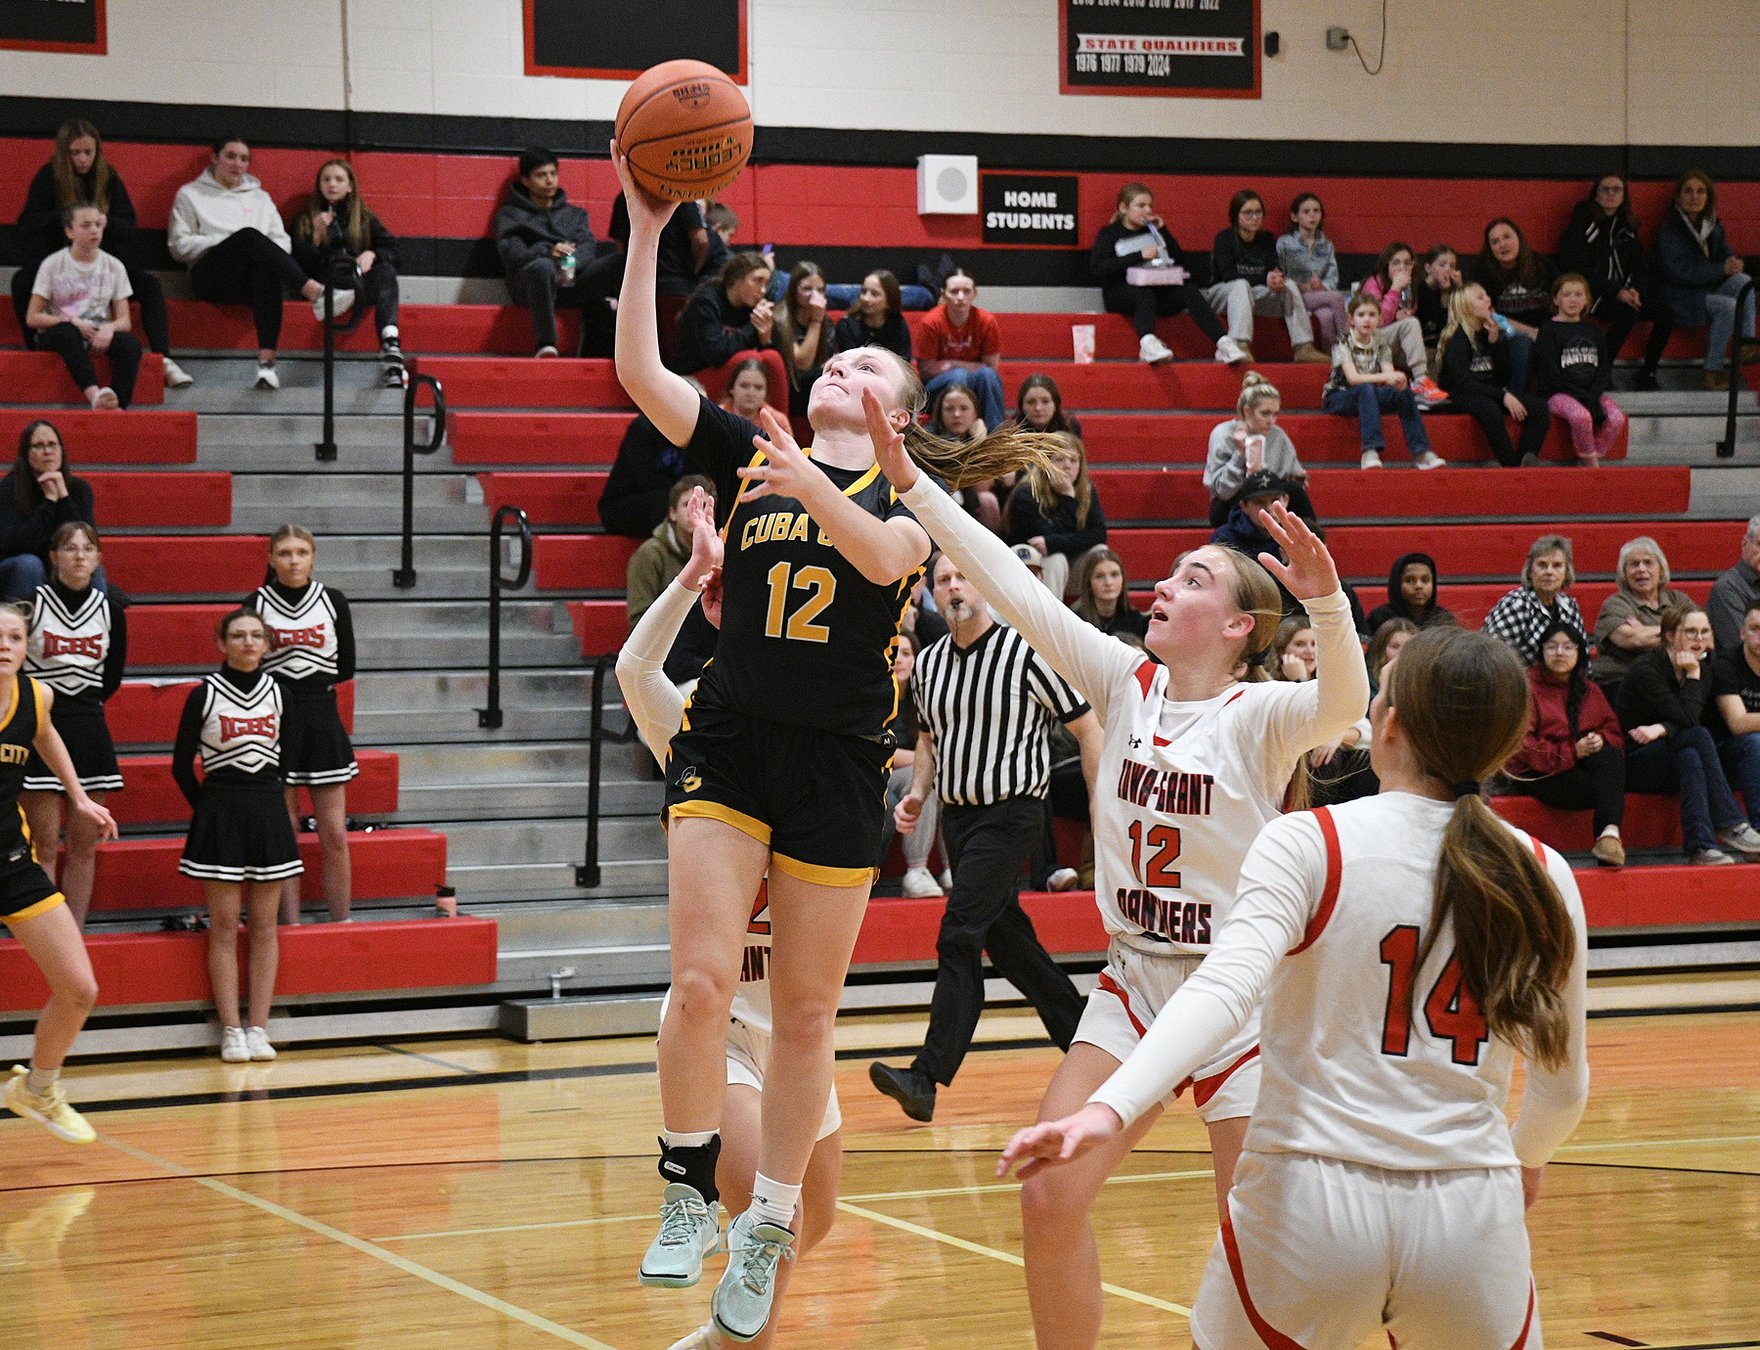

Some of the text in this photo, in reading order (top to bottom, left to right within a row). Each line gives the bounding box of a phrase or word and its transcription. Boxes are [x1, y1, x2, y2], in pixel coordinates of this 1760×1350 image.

[1085, 39, 1238, 52] STATE QUALIFIERS
[1075, 54, 1171, 76] 1976 1977 1979 2024
[1004, 190, 1057, 208] HOME
[986, 211, 1075, 230] STUDENTS
[741, 512, 809, 551] CUBA
[765, 561, 837, 643] 12
[43, 630, 103, 660] IGHS
[218, 713, 276, 744] IGHS
[1128, 819, 1182, 889] 12
[1379, 924, 1490, 1067] 14
